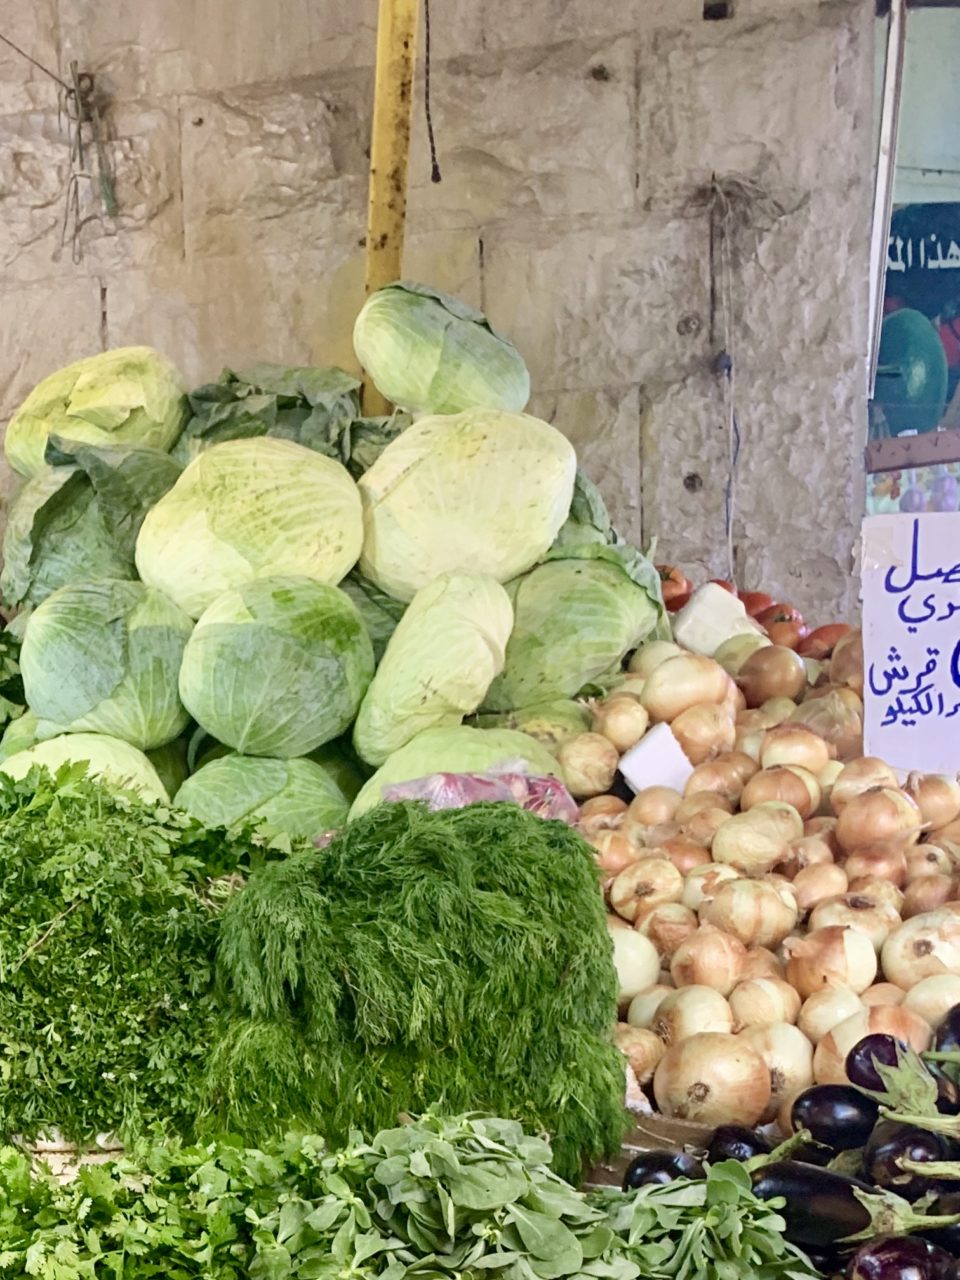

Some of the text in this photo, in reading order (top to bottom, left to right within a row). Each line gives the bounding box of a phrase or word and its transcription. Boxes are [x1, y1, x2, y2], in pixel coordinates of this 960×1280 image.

[885, 518, 960, 593] صل
[869, 646, 940, 696] قرش
[880, 683, 944, 727] الكيلو
